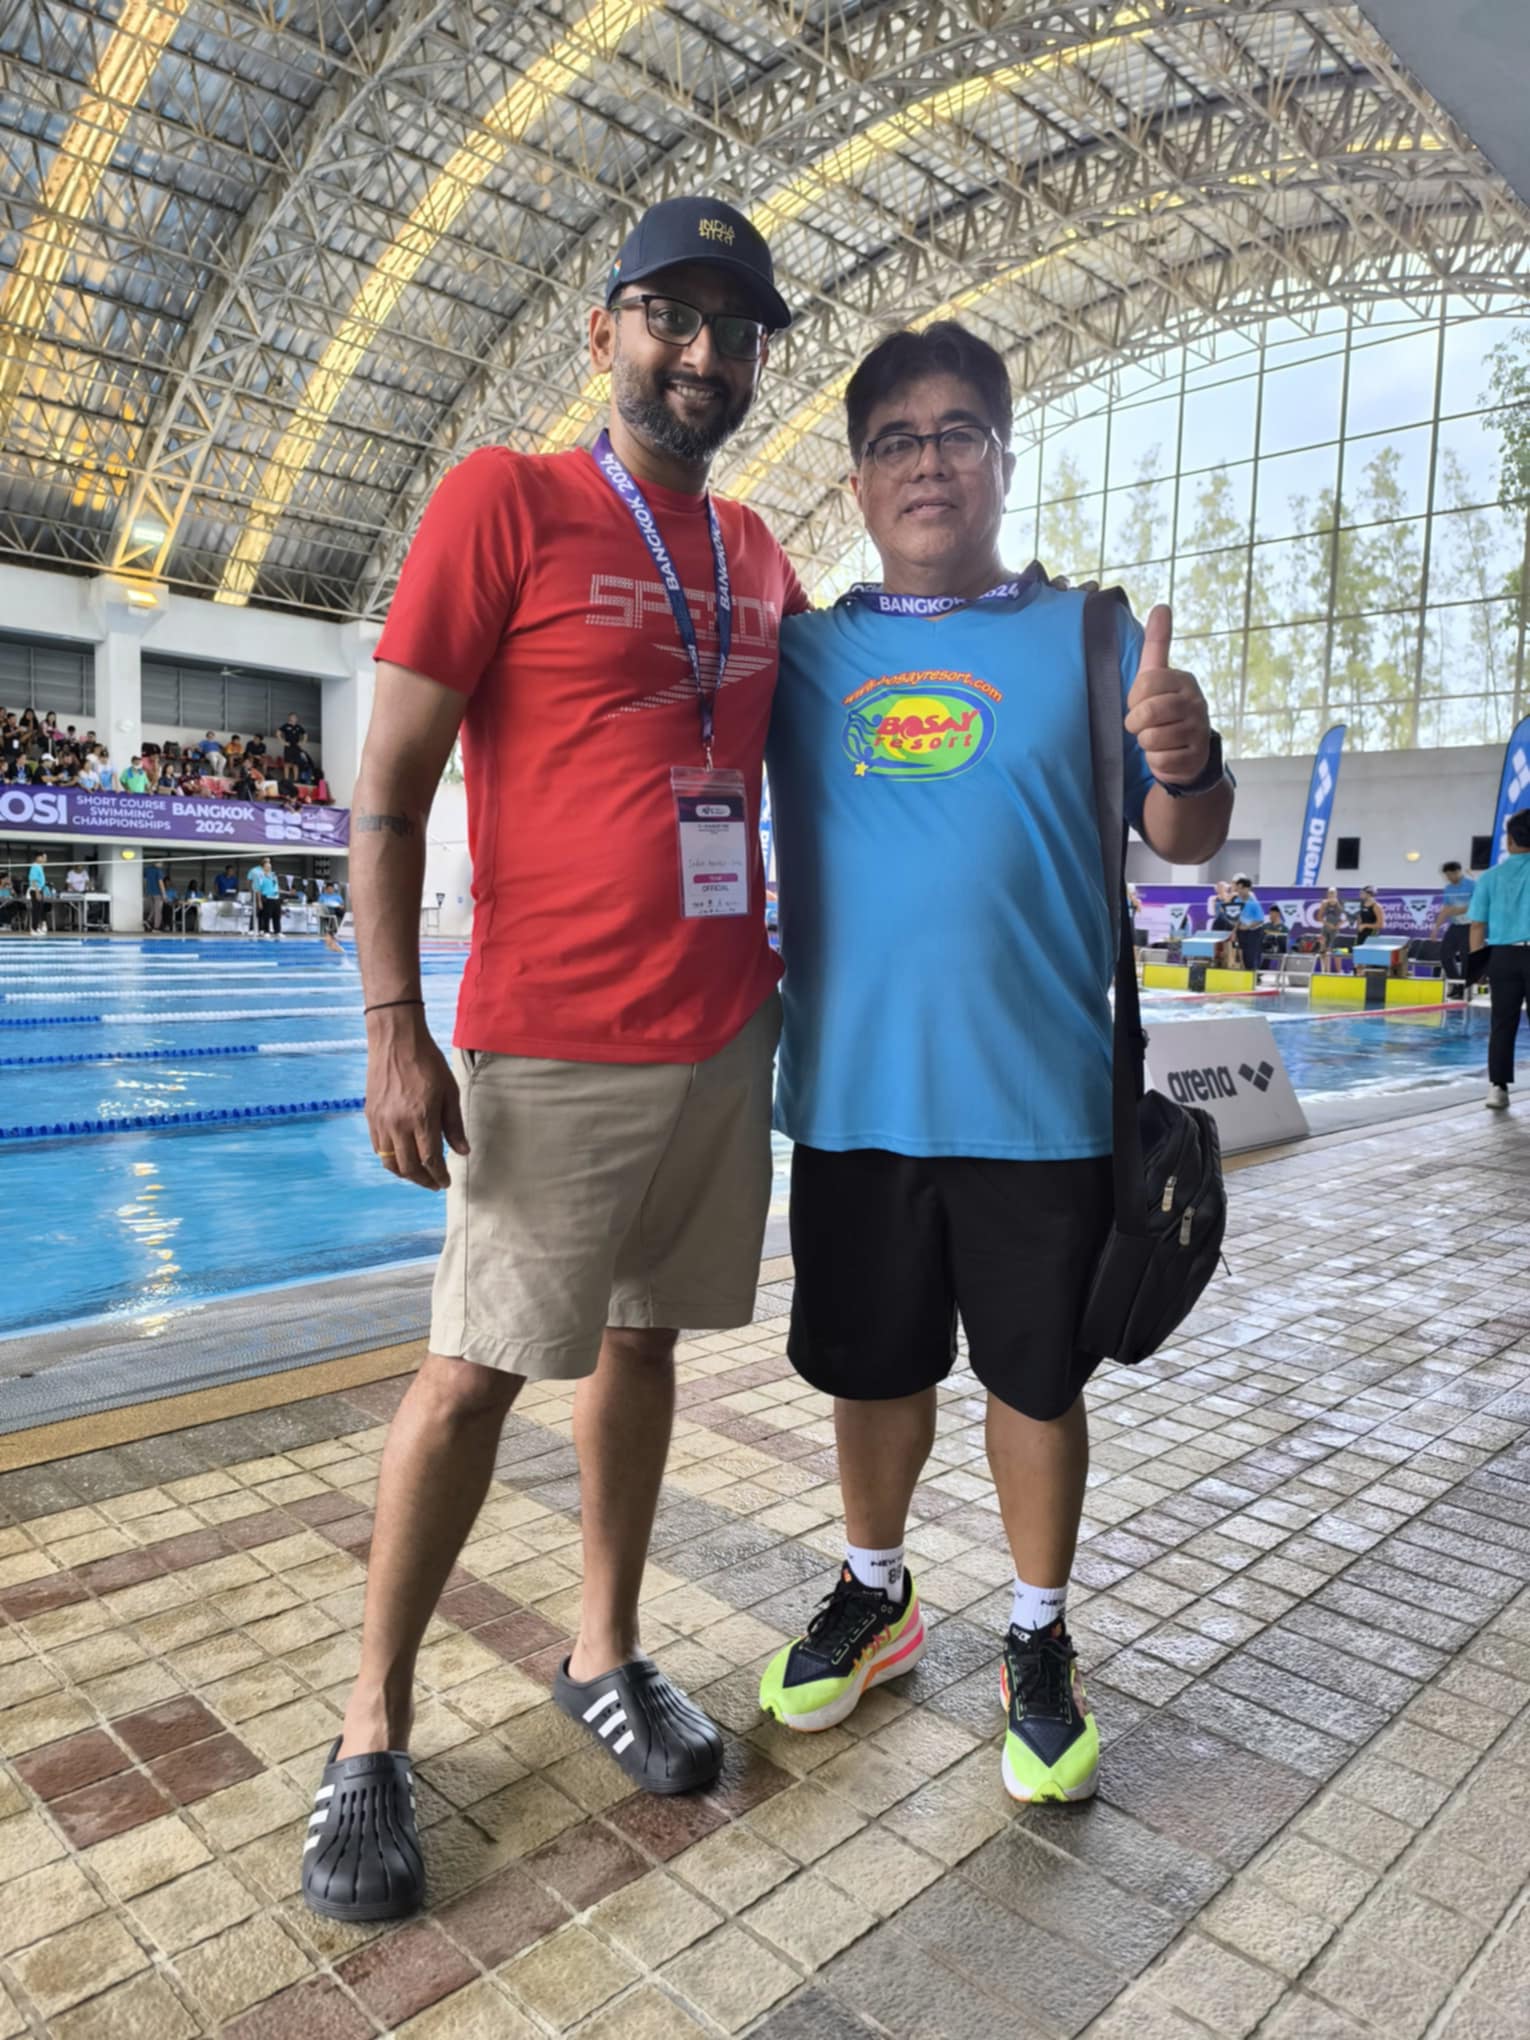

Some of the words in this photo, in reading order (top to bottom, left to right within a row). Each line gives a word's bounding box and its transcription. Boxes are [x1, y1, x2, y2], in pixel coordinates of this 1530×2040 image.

[699, 218, 735, 238] INDIA
[599, 451, 635, 493] 2024
[624, 495, 680, 592] BANGKOK
[876, 708, 981, 738] BOSAY
[873, 734, 973, 751] resort
[0, 790, 68, 825] OSI
[76, 795, 117, 807] SHORT
[119, 799, 167, 810] COURSE
[172, 802, 255, 821] BANGKOK
[89, 806, 155, 820] SWIMMING
[72, 815, 171, 831] CHAMPIONSHIPS
[195, 820, 235, 834] 2024
[1167, 1065, 1238, 1103] arena
